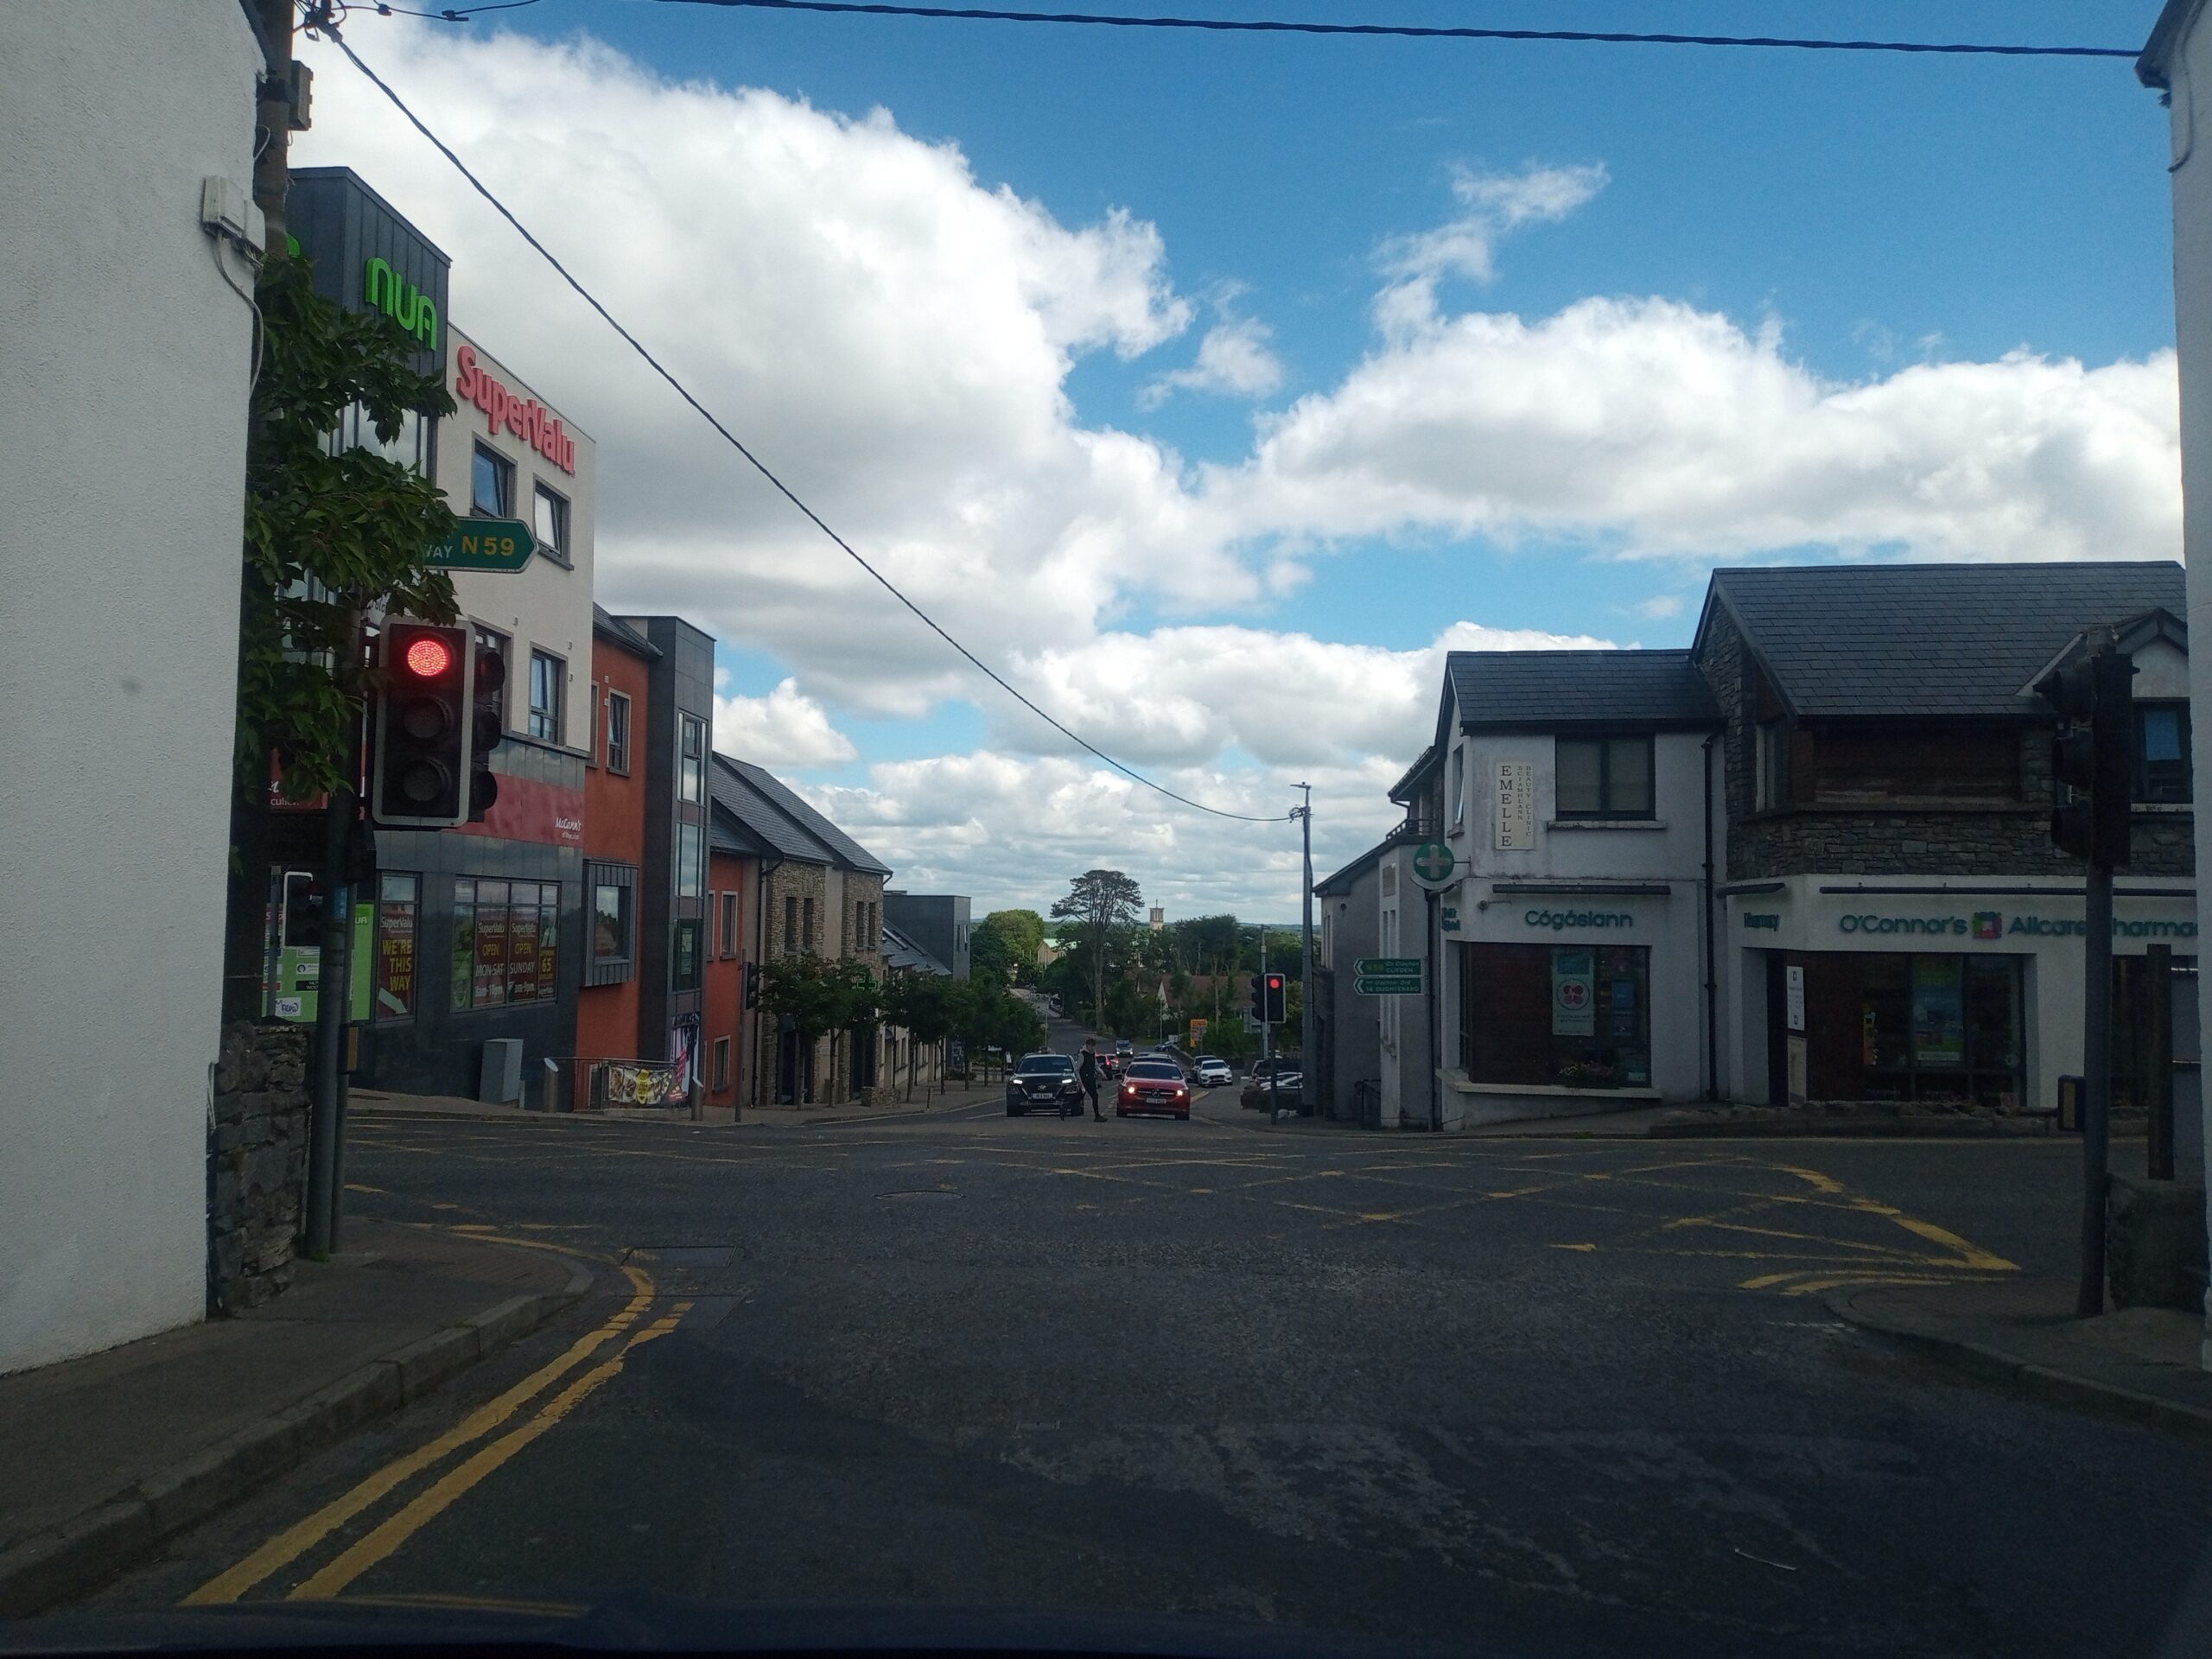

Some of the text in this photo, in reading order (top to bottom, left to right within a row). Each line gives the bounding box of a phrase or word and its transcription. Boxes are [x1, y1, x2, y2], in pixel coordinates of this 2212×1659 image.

[456, 345, 576, 478] SuperValu
[1499, 765, 1513, 847] EMELLE
[382, 939, 413, 955] WE'RE
[482, 944, 499, 957] OPEN
[514, 943, 532, 955] OPEN
[389, 957, 411, 973] THIS
[510, 962, 535, 975] SUNDAY
[389, 975, 411, 991] WAY
